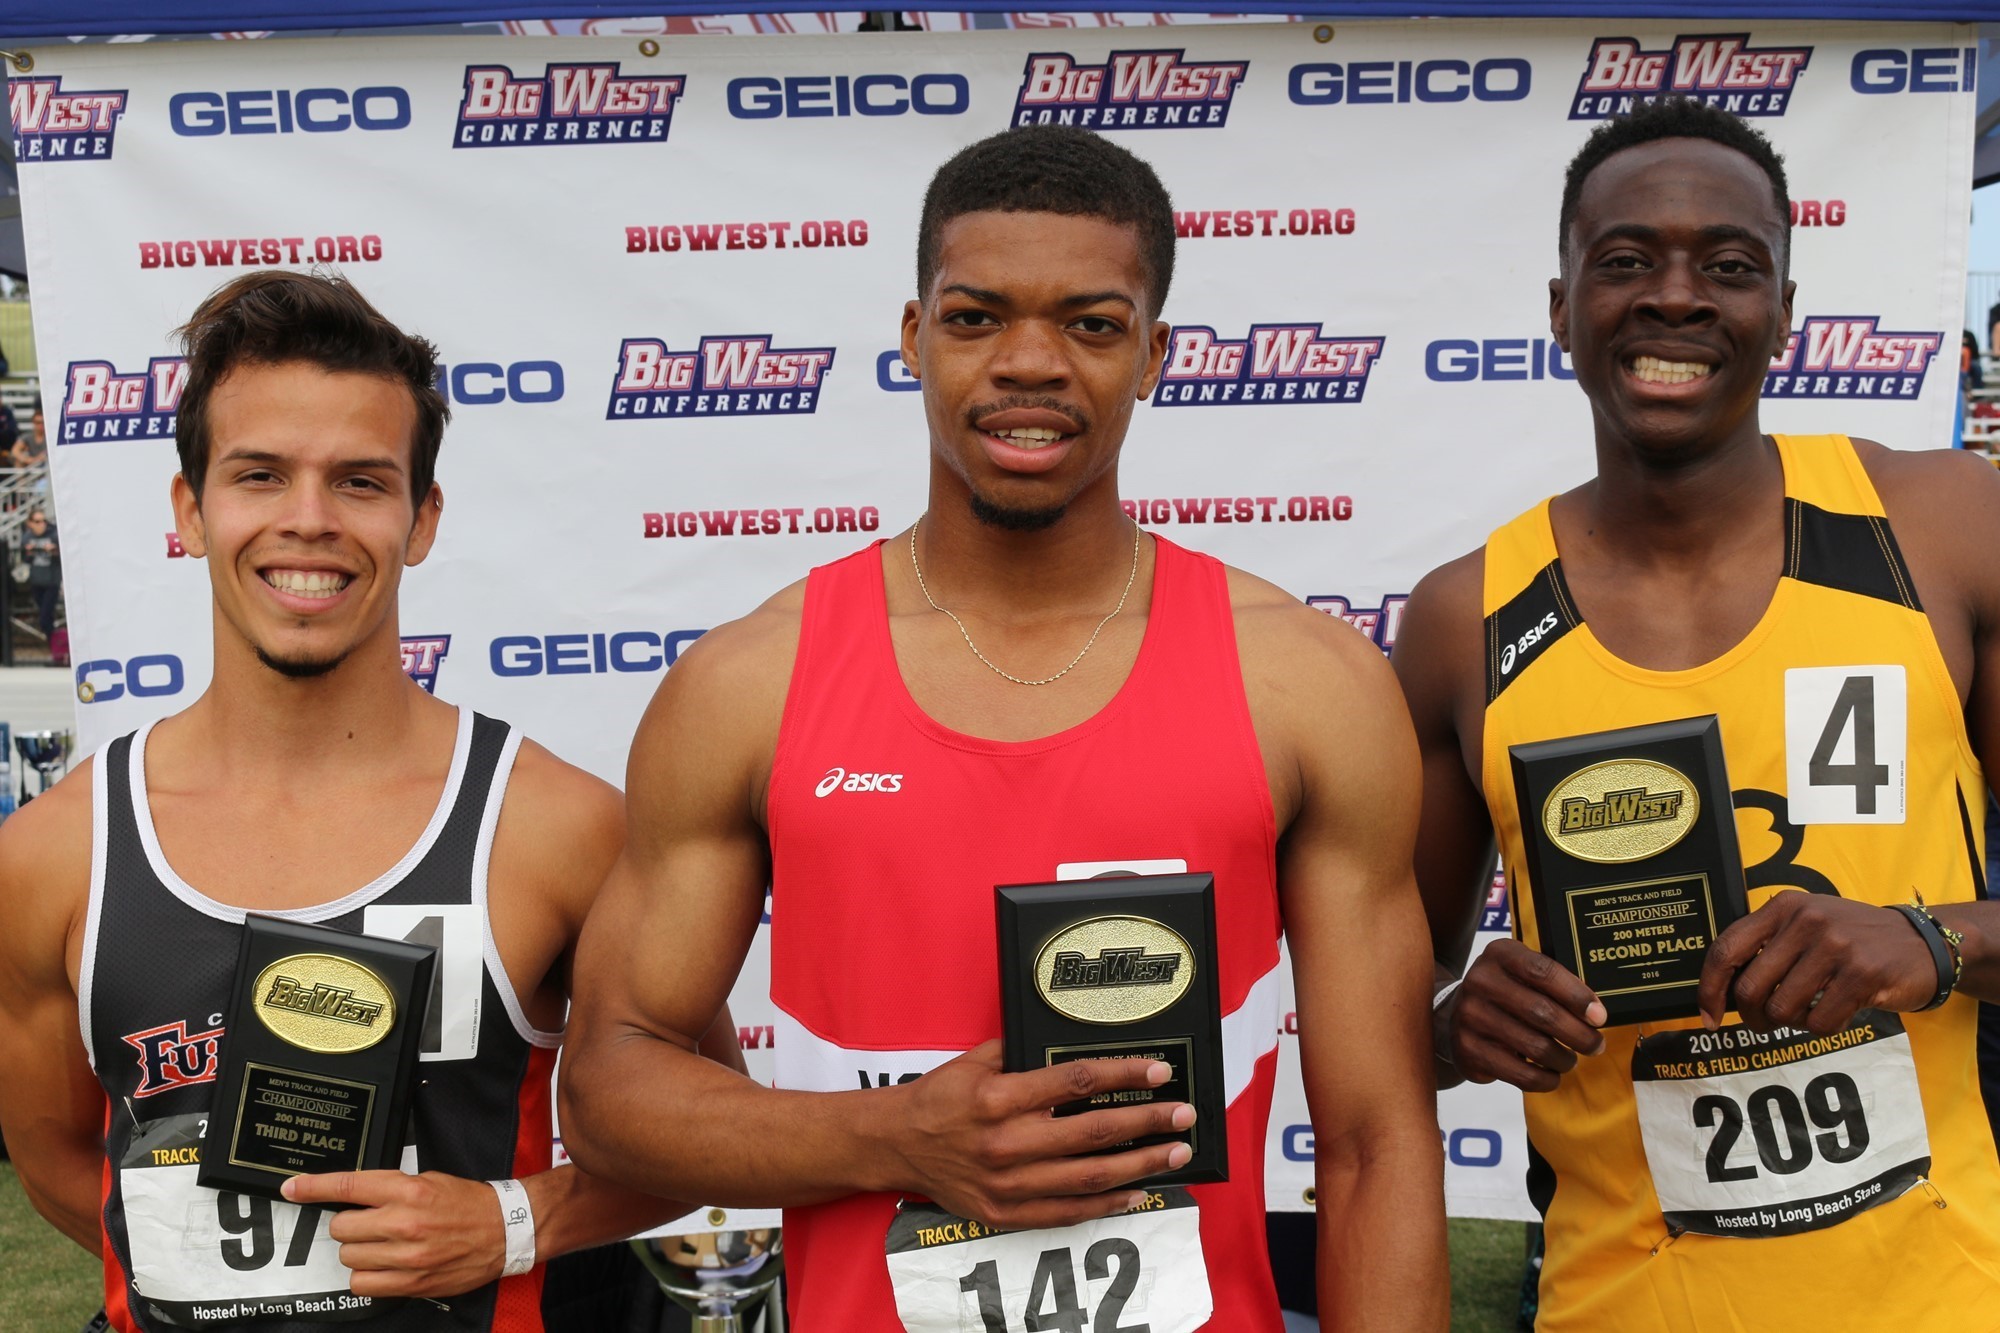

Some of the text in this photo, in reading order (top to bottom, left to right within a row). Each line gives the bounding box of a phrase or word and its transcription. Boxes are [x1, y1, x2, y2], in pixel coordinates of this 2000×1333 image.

[1021, 54, 1243, 104] BIG WEST
[1583, 39, 1806, 90] BIG WEST
[1850, 48, 1977, 94] GEI
[462, 66, 681, 119] BIG WEST
[727, 74, 969, 119] GEICO
[1288, 58, 1532, 105] GEICO
[168, 86, 411, 137] GEICO
[1018, 105, 1222, 126] CONFERENCE
[461, 119, 665, 143] CONFERENCE
[140, 235, 383, 269] BIGWEST.ORG
[625, 219, 869, 253] BIGWEST.ORG
[1163, 328, 1380, 380] BIG WEST
[1803, 320, 1938, 373] WEST
[616, 341, 698, 391] BIG
[703, 339, 831, 388] WEST
[66, 364, 146, 416] BIG
[614, 392, 812, 415] CONFERENCE
[1160, 381, 1360, 402] CONFERENCE
[643, 506, 880, 539] BIGWEST.ORG
[1808, 676, 1889, 815] 4
[1565, 793, 1678, 829] BIG WEST
[1594, 888, 1682, 907] MEN'S TRACK AND FIELD
[1592, 903, 1690, 926] CHAMPIONSHIP
[1613, 924, 1675, 941] 200 METERS
[1589, 936, 1705, 963] SECOND PLACE
[1056, 953, 1176, 985] BIG WEST
[1642, 971, 1660, 979] 2016
[269, 980, 378, 1024] BIG WEST
[1654, 1062, 1696, 1079] TRACK
[1697, 1062, 1709, 1077] &
[1710, 1055, 1750, 1074] FIELD
[1751, 1024, 1876, 1069] CHAMPIONSHIPS
[1689, 1032, 1735, 1054] 2016
[261, 1091, 351, 1118] CHAMPIONSHIP
[268, 1077, 350, 1100] MEN'S TRACK AND FIELD
[1090, 1090, 1154, 1104] 200 METERS
[255, 1122, 346, 1151] THIRD PLACE
[274, 1112, 332, 1131] 200 METERS
[1692, 1072, 1870, 1184] 209
[151, 1147, 200, 1165] TRACK
[287, 1157, 304, 1166] 2016
[1714, 1181, 1882, 1229] Hosted by Long Beach State
[217, 1190, 323, 1271] 97
[916, 1222, 964, 1247] TRACK
[968, 1221, 981, 1238] &
[959, 1237, 1151, 1333] 142
[193, 1295, 372, 1320] Hosted by Long Beach State
